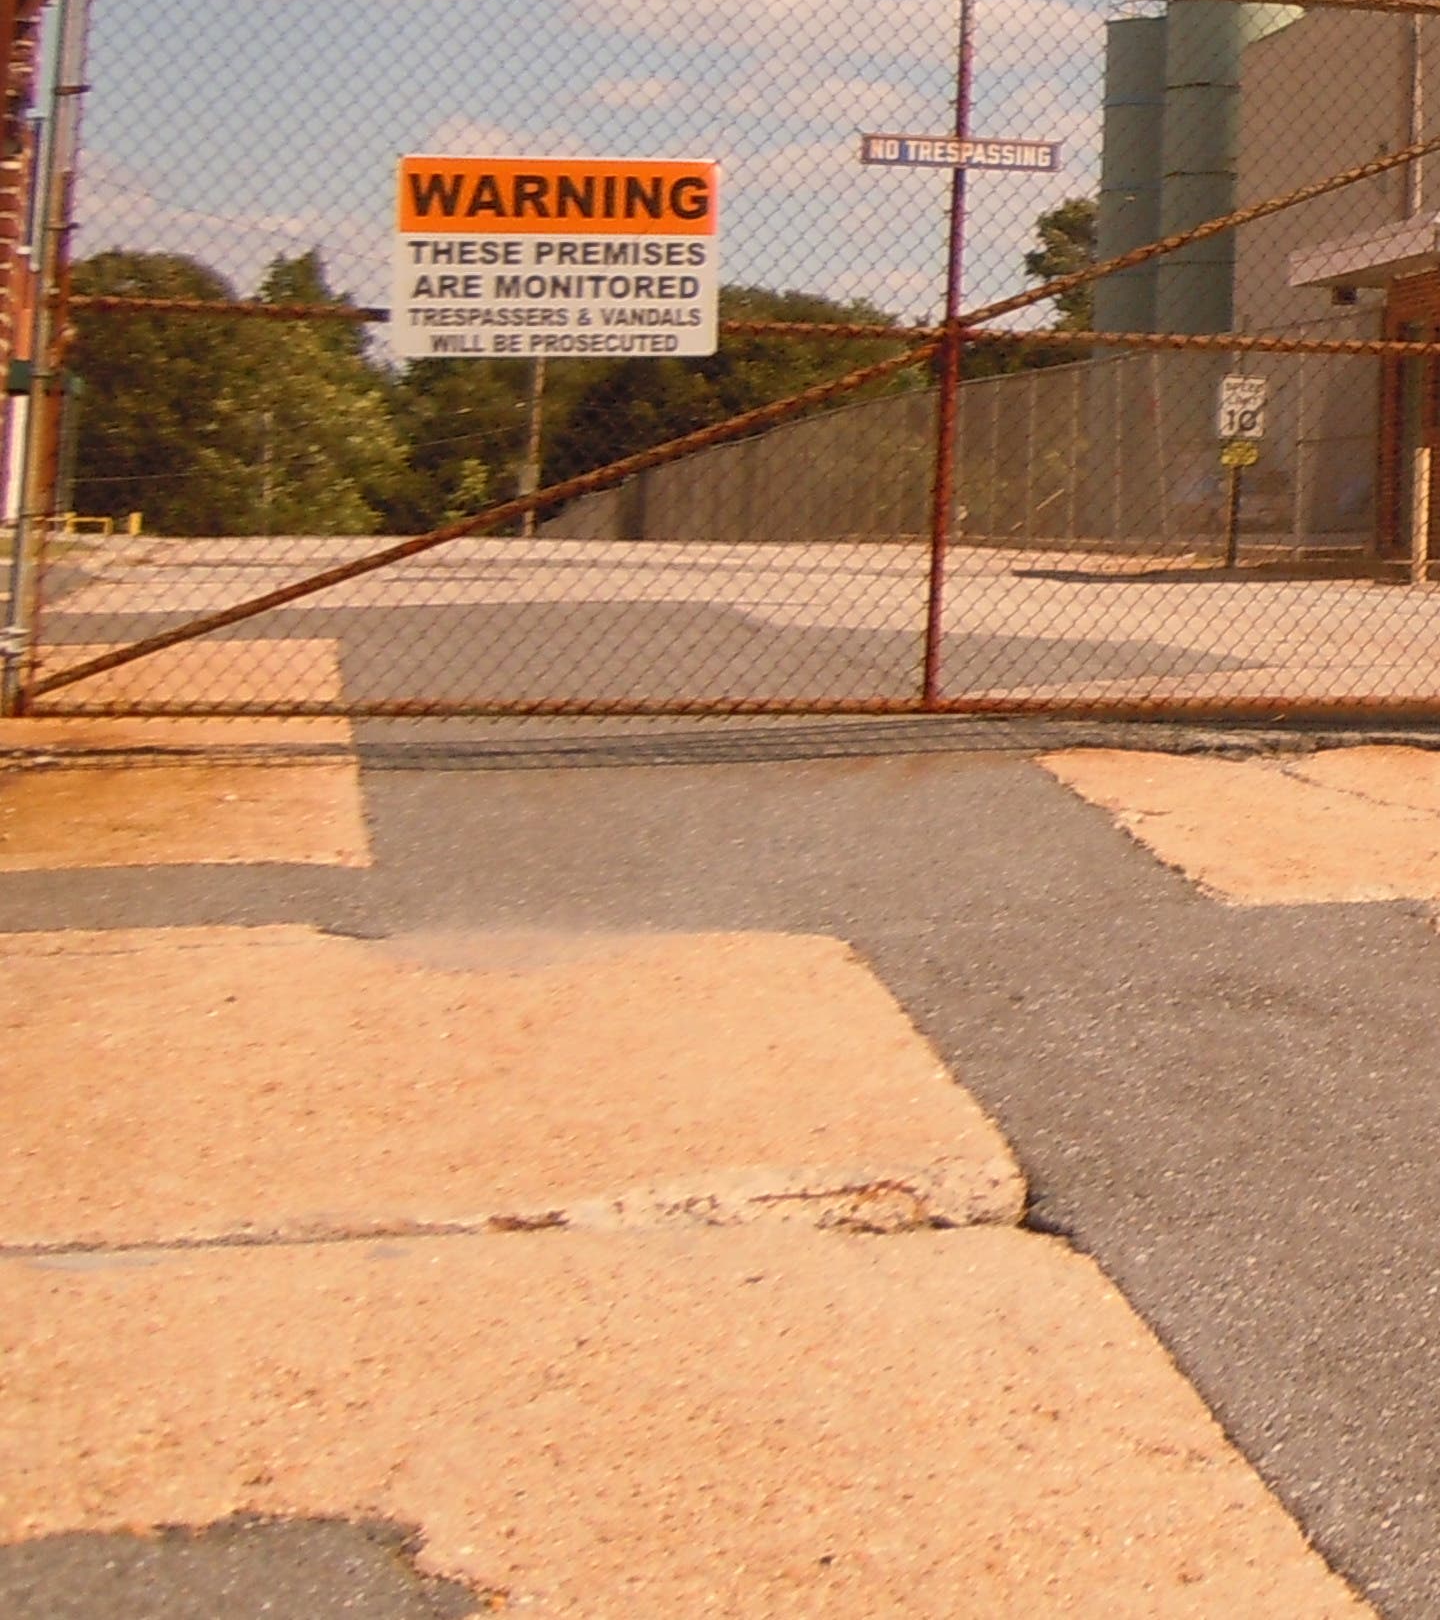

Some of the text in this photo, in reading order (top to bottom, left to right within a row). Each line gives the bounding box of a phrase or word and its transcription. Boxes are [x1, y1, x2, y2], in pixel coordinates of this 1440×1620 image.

[870, 139, 1051, 168] NO TRESPASSING
[408, 173, 709, 220] WARNING
[408, 240, 706, 266] THESE PREMISES
[411, 275, 699, 299] ARE MONITORED
[408, 308, 701, 327] TRESPASSERS & VANDALS
[430, 334, 678, 352] WILL BE PROSECUTED
